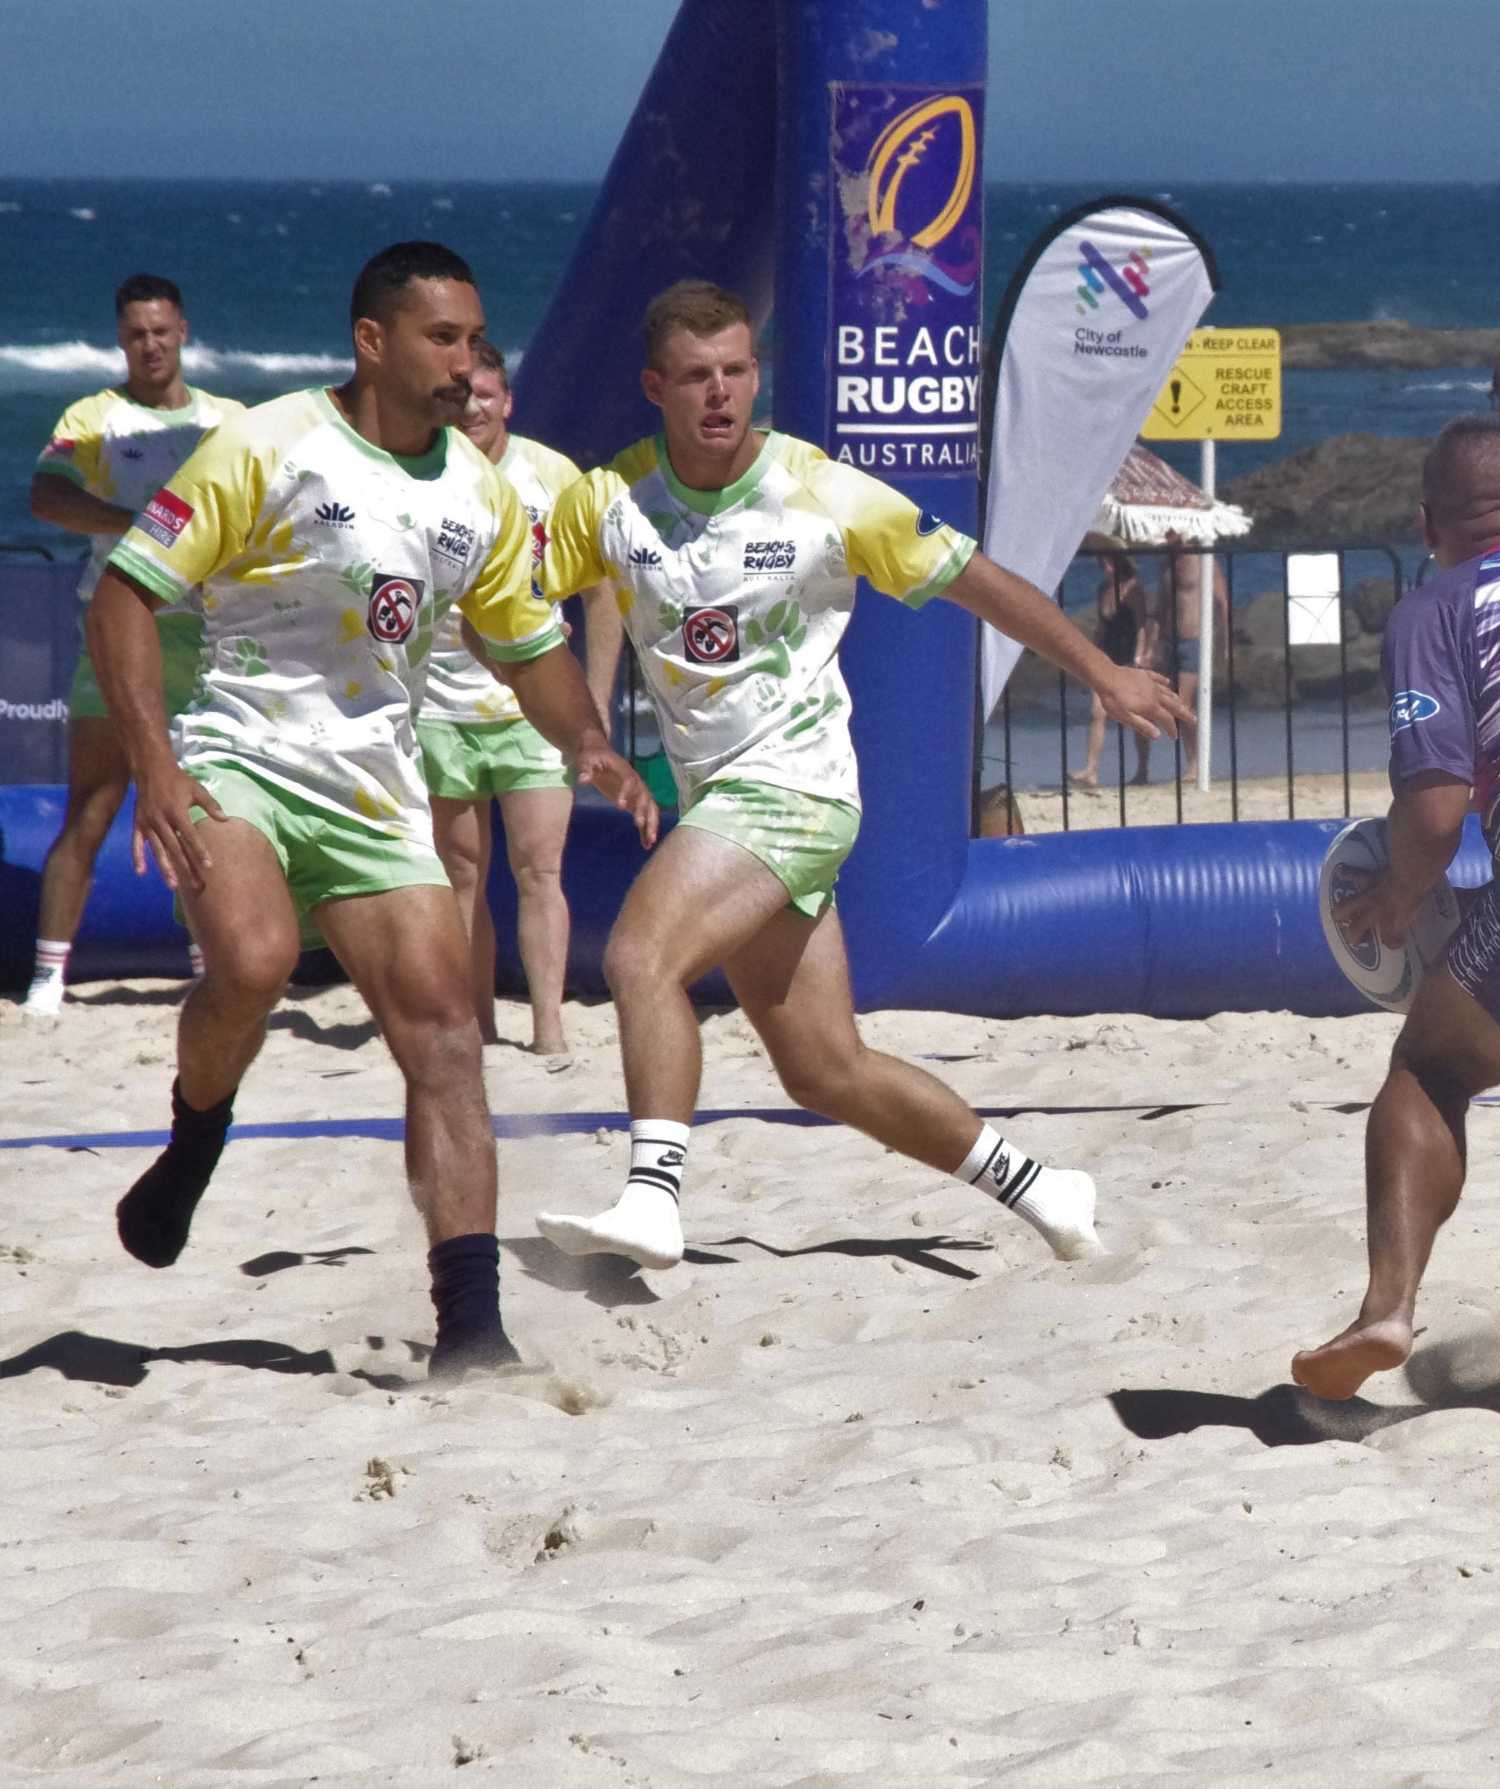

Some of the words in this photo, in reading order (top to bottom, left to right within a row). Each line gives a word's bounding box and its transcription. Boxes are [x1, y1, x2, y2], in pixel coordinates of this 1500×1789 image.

[1074, 327, 1104, 344] City
[1106, 329, 1122, 344] of
[1203, 338, 1233, 350] KEEP
[1236, 338, 1276, 350] CLEAR
[838, 325, 981, 367] BEACH
[1074, 340, 1148, 358] Newcastle
[1215, 367, 1273, 380] RESCUE
[836, 375, 979, 414] RUGBY
[1220, 383, 1267, 395] CRAFT
[1215, 398, 1273, 410] ACCESS
[1225, 414, 1264, 426] AREA
[149, 524, 175, 546] HIRE
[743, 553, 796, 571] RUGBY
